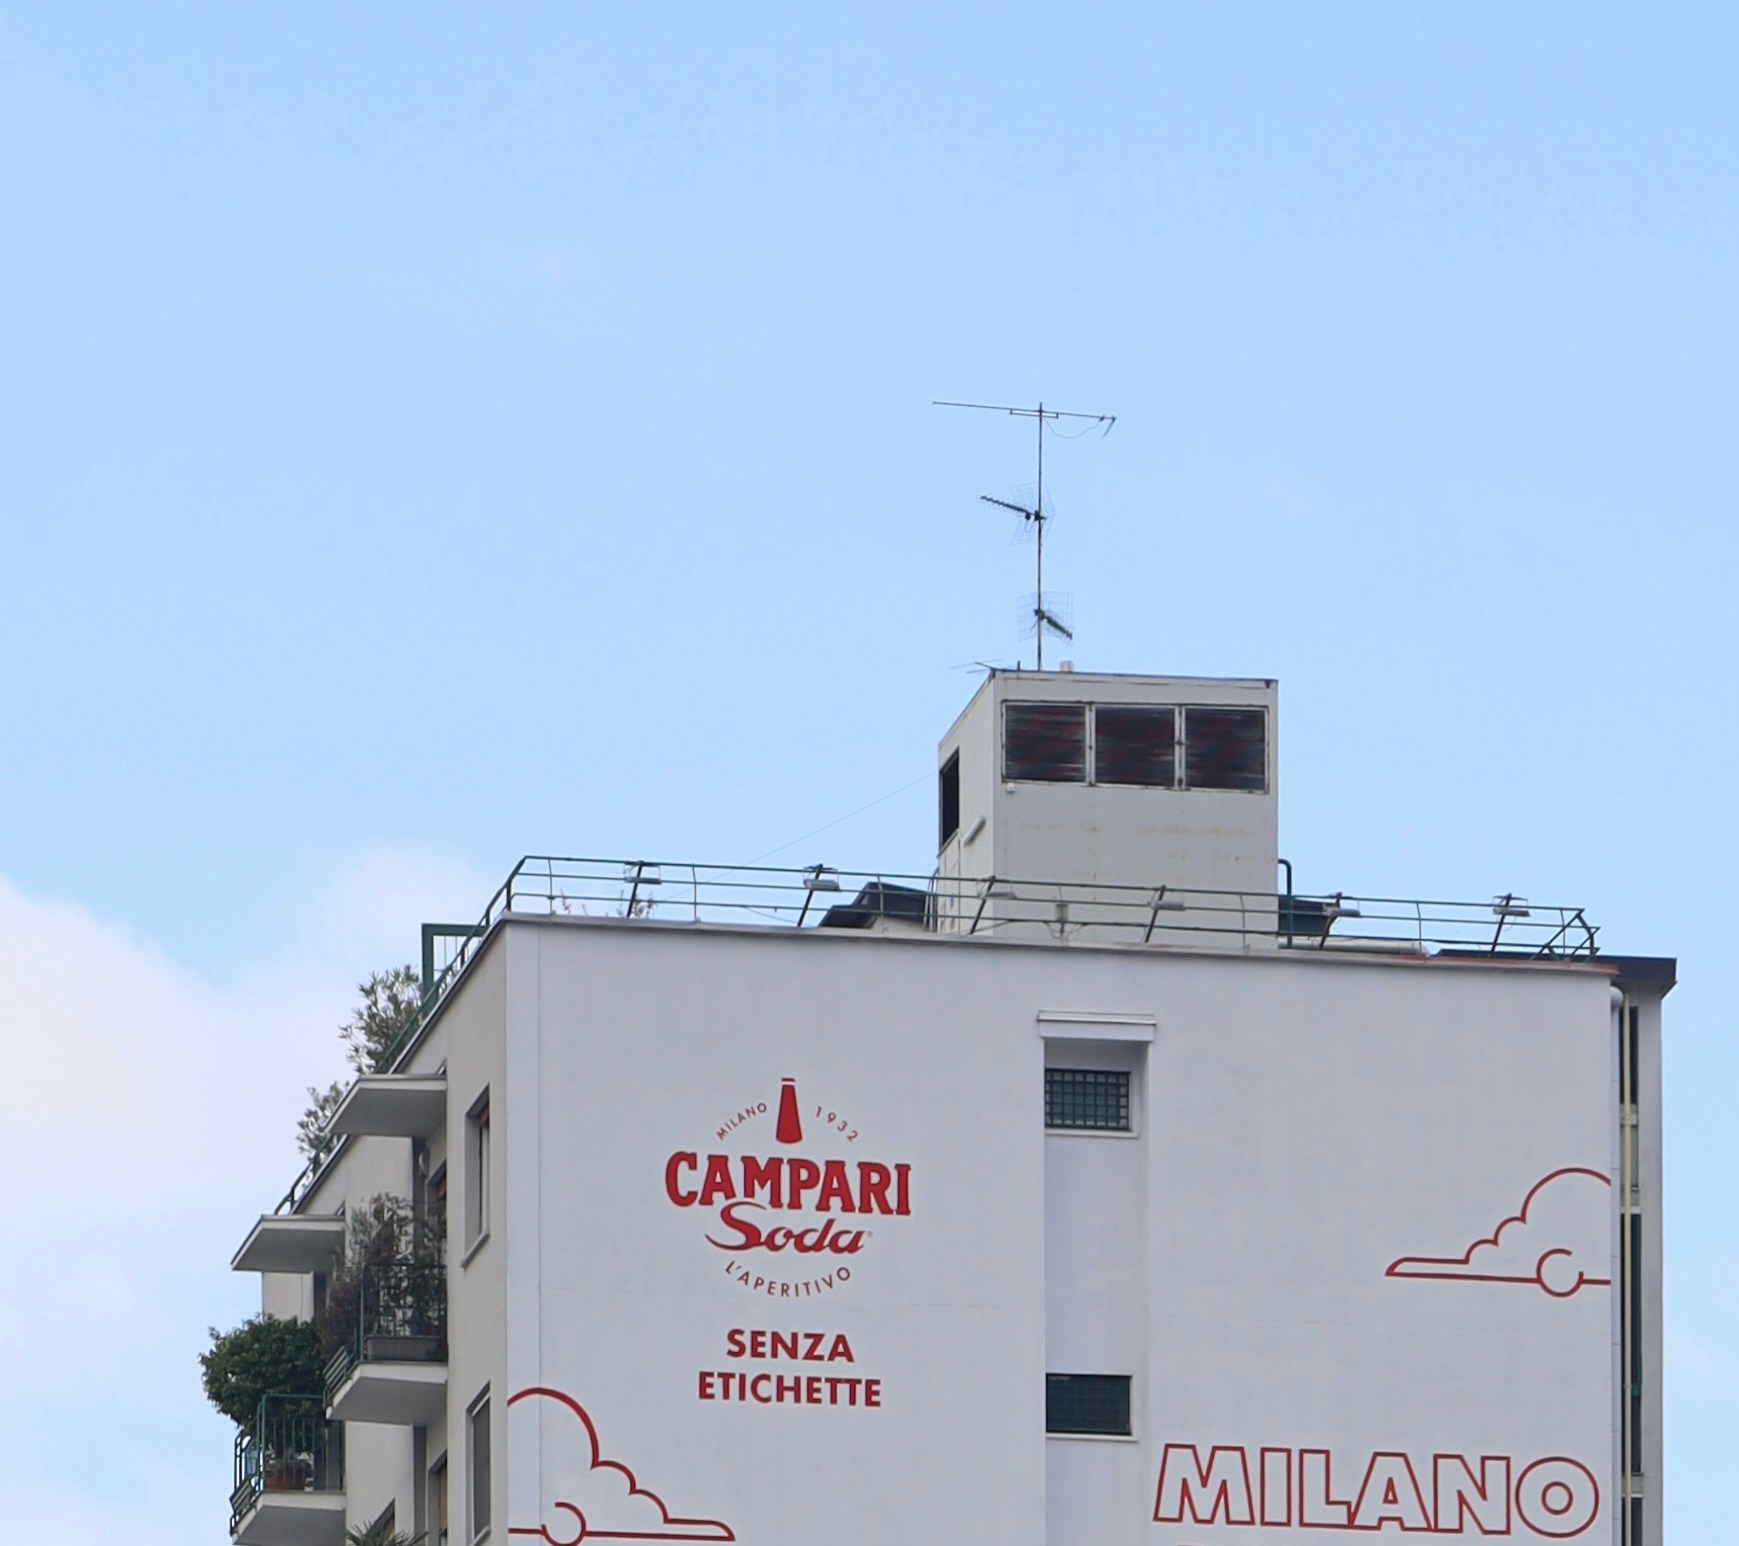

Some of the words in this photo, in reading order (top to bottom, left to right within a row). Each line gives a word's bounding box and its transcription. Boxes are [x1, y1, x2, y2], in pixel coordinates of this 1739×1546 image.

[716, 1101, 768, 1142] MILANO
[814, 1105, 860, 1143] 1932
[664, 1150, 912, 1216] CAMPARI
[725, 1260, 852, 1298] L'APERITIVO
[726, 1329, 855, 1364] SENZA
[698, 1371, 882, 1408] ETICHETTE
[1153, 1444, 1600, 1538] MILANO
